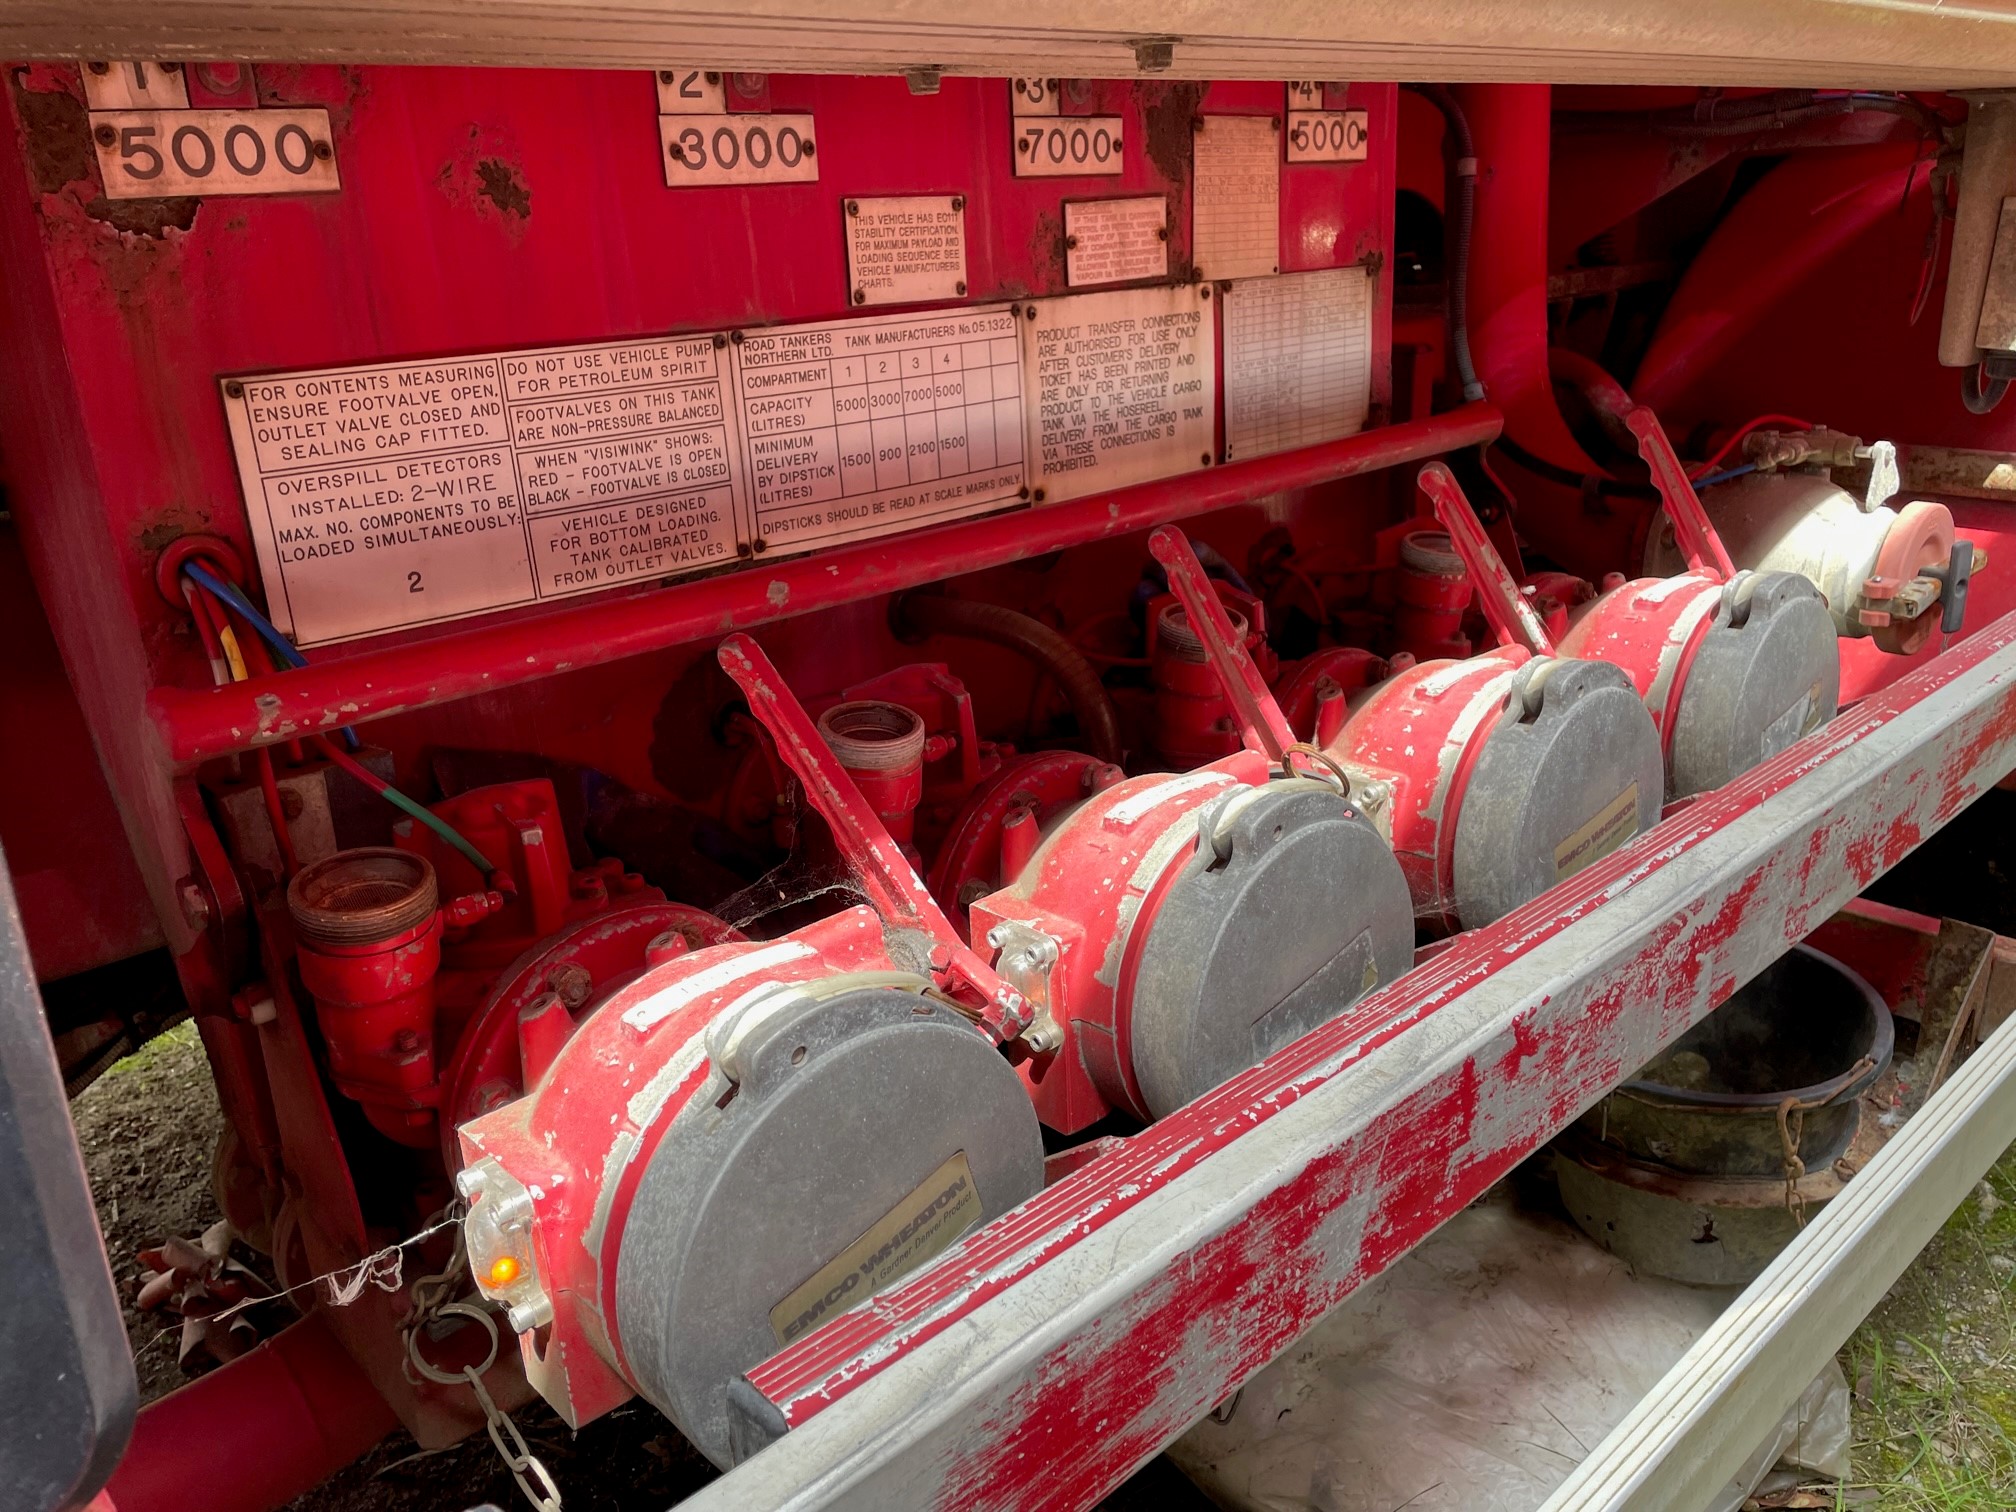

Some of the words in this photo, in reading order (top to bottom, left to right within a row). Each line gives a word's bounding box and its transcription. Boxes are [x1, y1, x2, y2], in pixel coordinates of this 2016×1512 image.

[680, 71, 702, 97] 2
[1027, 78, 1044, 103] 3
[1300, 81, 1312, 101] 4
[679, 127, 801, 170] 3000
[1026, 128, 1110, 163] 7000
[1296, 120, 1360, 151] 5000
[121, 124, 314, 180] 5000
[855, 216, 874, 225] THIS
[878, 214, 913, 224] VEHICLE
[917, 214, 933, 223] HAS
[855, 227, 895, 238] STABILITY
[856, 242, 870, 251] FOR
[912, 238, 943, 248] PAYLOAD
[857, 253, 893, 264] LOADING
[897, 251, 940, 261] SEQUENCE
[944, 250, 959, 259] SEE
[857, 265, 891, 276] VEHICLE
[894, 262, 959, 274] MANUFACTURERS
[743, 339, 776, 352] ROAD
[780, 333, 832, 348] TANKERS
[845, 336, 871, 348] TANK
[875, 326, 955, 344] MANUFACTURERS
[1037, 327, 1080, 343] PRODUCT
[1088, 320, 1135, 336] TRANSFER
[1038, 345, 1056, 358] ARE
[1128, 333, 1145, 344] FOR
[1152, 329, 1169, 342] USE
[1176, 326, 1197, 338] ONLY
[507, 362, 527, 376] DO
[536, 359, 565, 372] NOT
[574, 354, 602, 368] USE
[610, 348, 669, 365] VEHICLE
[676, 343, 712, 358] PUMP
[745, 349, 806, 365] NORTHERN
[811, 347, 834, 358] LTD.
[747, 369, 827, 388] COMPARTMENT
[846, 366, 850, 377] 1
[879, 362, 886, 373] 2
[912, 358, 919, 369] 3
[943, 354, 950, 364] 4
[1040, 359, 1069, 374] AFTER
[1140, 343, 1181, 358] DELIVERY
[250, 387, 286, 402] FOR
[296, 376, 389, 397] CONTENTS
[399, 366, 494, 387] MEASURING
[518, 376, 550, 393] FOR
[559, 367, 653, 389] PETROLEUM
[661, 361, 707, 377] SPIRIT
[1040, 372, 1071, 387] TICKET
[1079, 369, 1097, 381] HAS
[1041, 391, 1059, 402] ARE
[1066, 385, 1089, 398] ONLY
[1096, 380, 1113, 393] FOR
[254, 402, 329, 422] ENSURE
[339, 390, 442, 413] FOOTVALVE
[517, 402, 612, 423] FOOTVALVES
[620, 397, 637, 410] ON
[647, 392, 675, 406] THIS
[682, 388, 716, 402] TANK
[750, 396, 813, 415] CAPACITY
[836, 398, 866, 412] 5000
[871, 393, 901, 407] 3000
[904, 388, 932, 402] 7000
[936, 384, 962, 397] 5000
[1041, 401, 1082, 417] PRODUCT
[1108, 393, 1124, 406] THE
[1131, 386, 1167, 402] VEHICLE
[1174, 380, 1202, 394] CARGO
[258, 422, 327, 442] OUTLET
[336, 415, 392, 433] VALVE
[400, 407, 462, 426] CLOSED
[470, 402, 500, 418] AND
[518, 427, 545, 442] ARE
[552, 412, 652, 437] NON-PRESSURE
[659, 404, 719, 422] BALANCED
[752, 415, 805, 432] (LITRES)
[1042, 417, 1064, 432] TANK
[1072, 414, 1086, 426] VIA
[1093, 410, 1110, 422] THE
[1042, 429, 1086, 446] DELIVERY
[1093, 422, 1118, 437] FROM
[1126, 418, 1142, 430] THE
[1148, 412, 1177, 427] CARGO
[1183, 407, 1203, 420] TANK
[282, 439, 366, 460] SEALING
[376, 433, 410, 448] CAP
[421, 424, 489, 442] FITTED.
[535, 452, 577, 468] WHEN
[584, 441, 657, 461] "VISIWINK"
[665, 433, 713, 449] SHOWS:
[755, 436, 813, 454] MINIMUM
[842, 453, 871, 467] 1500
[879, 448, 901, 461] 900
[909, 442, 935, 456] 2100
[940, 436, 965, 449] 1500
[1043, 448, 1058, 460] VIA
[1066, 440, 1093, 455] THESE
[278, 469, 388, 495] OVERSPILL
[397, 453, 502, 479] DETECTORS
[529, 473, 558, 488] RED
[582, 456, 663, 479] FOOTVALVE
[670, 455, 682, 466] IS
[689, 448, 722, 463] OPEN
[757, 452, 818, 471] DELIVERY
[759, 476, 775, 488] BY
[780, 466, 836, 484] DIPSTICK
[1043, 455, 1098, 475] PROHIBITED.
[292, 491, 404, 518] INSTALLED:
[411, 474, 497, 502] 2-WIRE
[528, 489, 570, 506] BLACK
[591, 475, 661, 496] FOOTVALVE
[667, 471, 678, 483] IS
[683, 464, 726, 480] CLOSED
[760, 487, 812, 504] (LITRES)
[279, 526, 319, 543] MAX.
[326, 521, 352, 535] NO.
[360, 504, 464, 530] COMPONENTS
[472, 500, 490, 514] TO
[498, 495, 514, 508] BE
[562, 511, 628, 532] VEHICLE
[637, 497, 706, 519] DESIGNED
[763, 515, 822, 535] DIPSTICKS
[827, 506, 869, 523] SHOULD
[873, 503, 885, 514] BE
[890, 497, 915, 510] READ
[919, 493, 930, 503] AT
[935, 487, 962, 501] SCALE
[966, 480, 996, 495] MARKS
[282, 540, 354, 563] LOADED
[365, 513, 521, 549] SIMULTANEOUSLY:
[551, 534, 581, 552] FOR
[590, 521, 651, 544] BOTTOM
[659, 511, 720, 532] LOADING.
[570, 548, 612, 565] TANK
[620, 530, 708, 556] CALIBRATED
[554, 568, 597, 586] FROM
[606, 555, 663, 576] OUTLET
[671, 543, 727, 563] VALVES.
[408, 572, 424, 592] 2
[880, 1247, 912, 1279] Gardner
[943, 1192, 972, 1224] Product
[782, 1274, 859, 1341] EMCO
[860, 1176, 967, 1273] WHEATON
